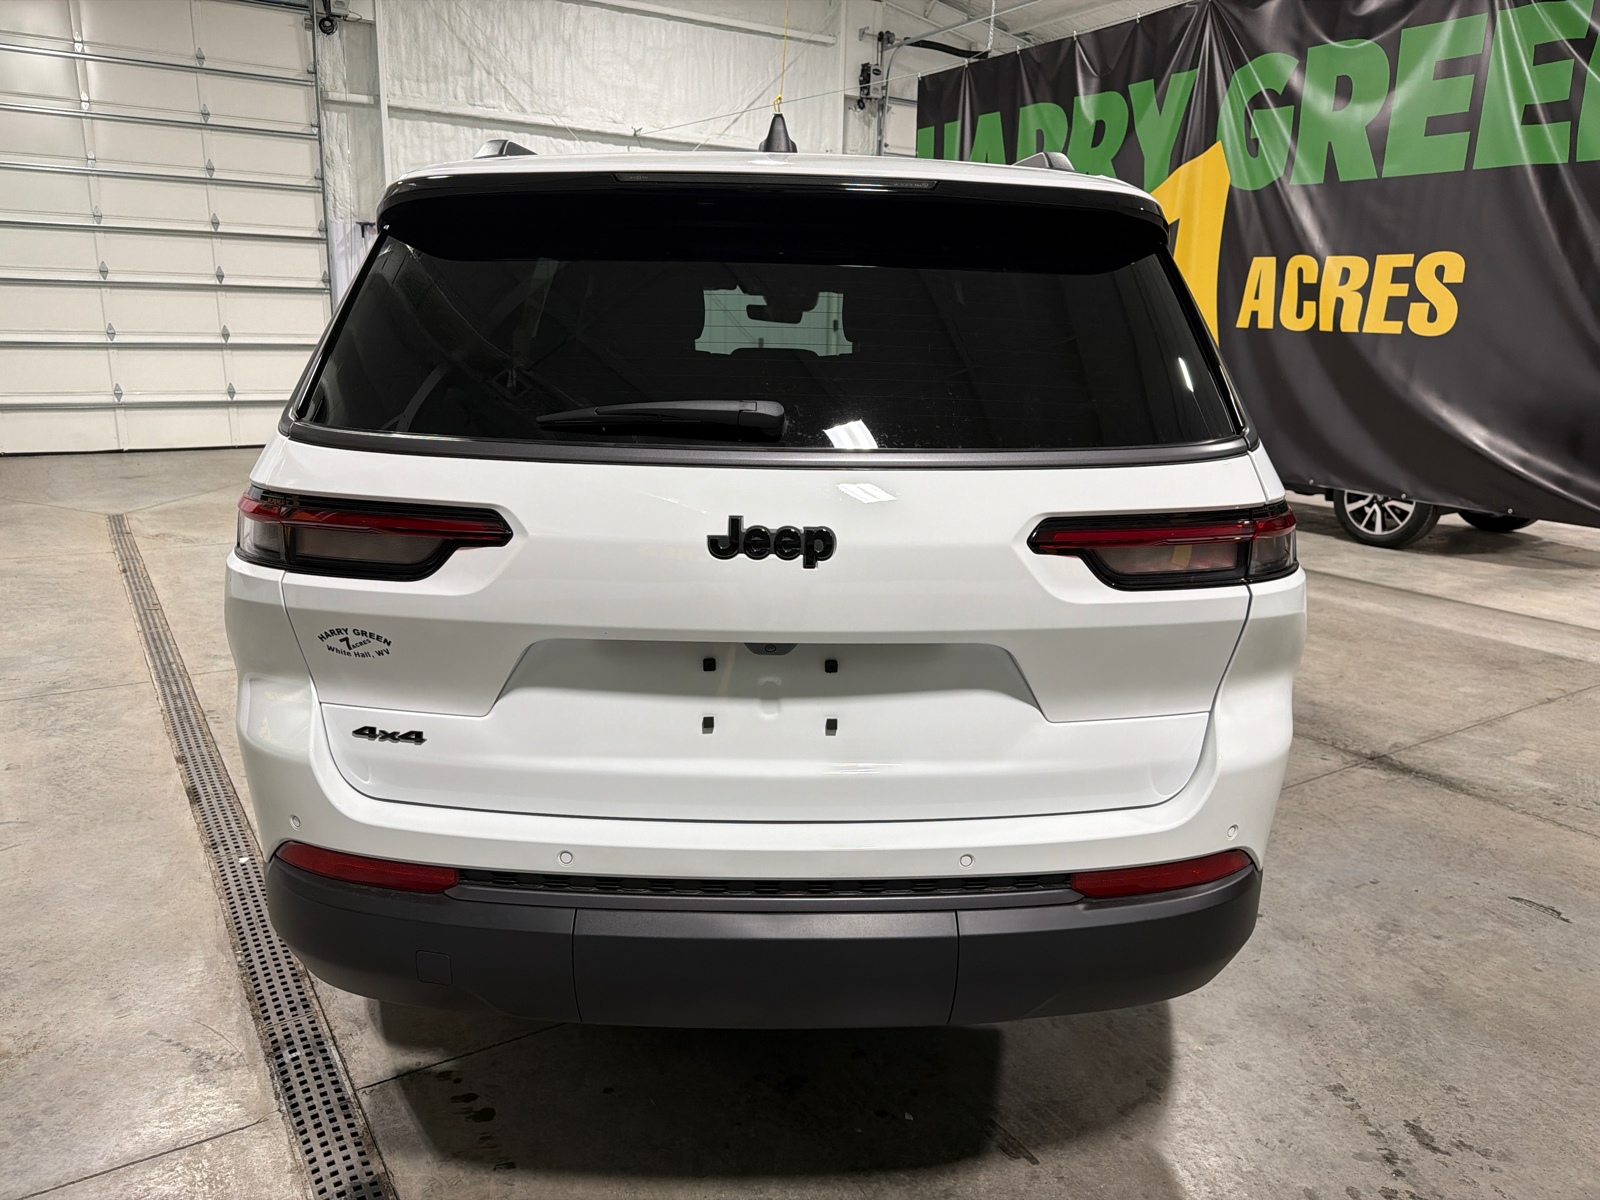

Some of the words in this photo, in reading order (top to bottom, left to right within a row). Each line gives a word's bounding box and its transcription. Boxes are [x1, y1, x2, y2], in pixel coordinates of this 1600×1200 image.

[1216, 0, 1600, 191] GREE
[1236, 251, 1465, 337] ACRES
[707, 515, 837, 569] Jeep
[317, 627, 349, 643] HARRY
[352, 628, 392, 647] GREEN
[338, 636, 352, 651] 7
[351, 638, 372, 650] ACRES
[326, 644, 352, 657] White
[353, 651, 375, 659] Hall,
[374, 648, 391, 657] WV
[351, 725, 427, 745] 4x4
